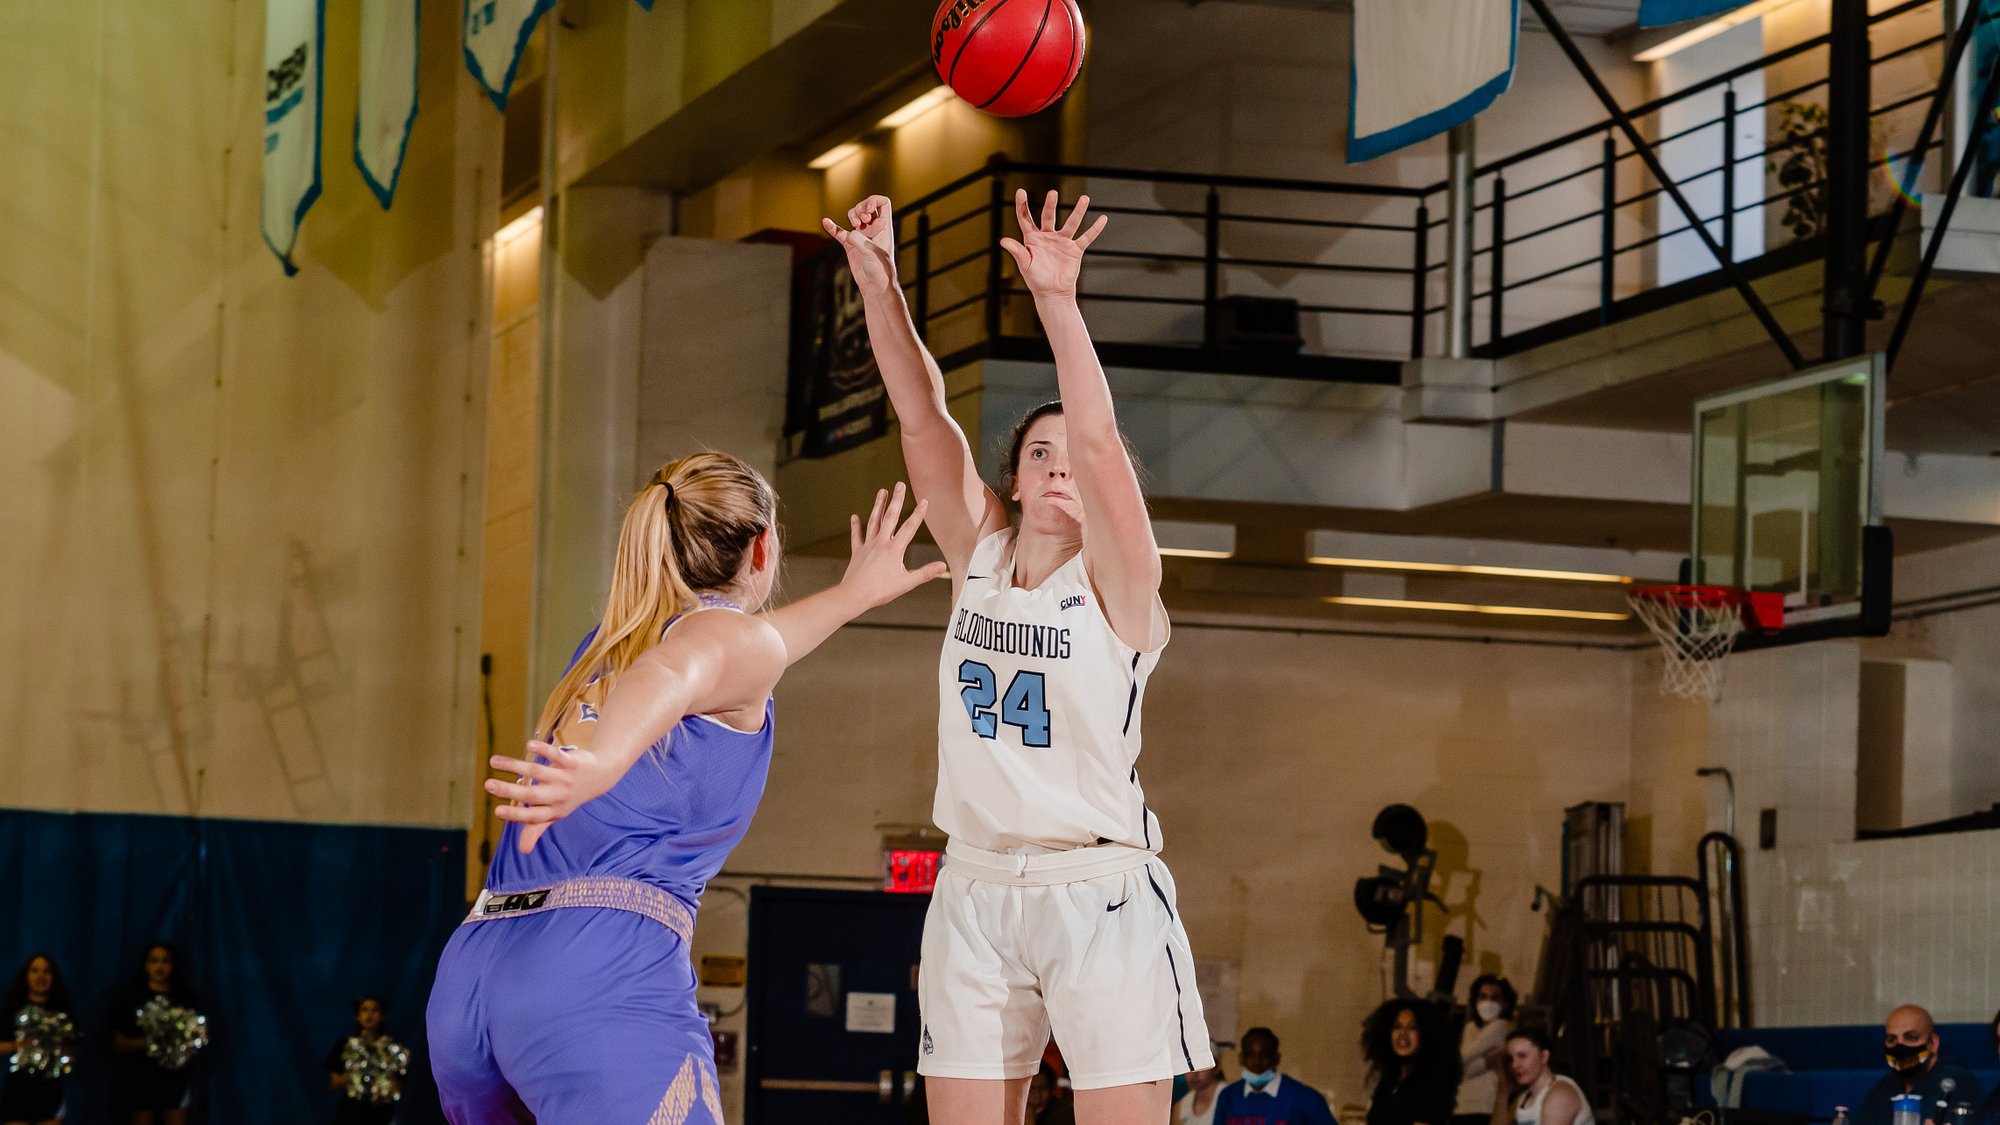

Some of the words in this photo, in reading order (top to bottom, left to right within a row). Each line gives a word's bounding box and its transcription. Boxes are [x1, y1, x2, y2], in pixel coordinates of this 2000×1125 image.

[1060, 595, 1086, 609] CUNY
[954, 608, 1071, 660] BLOODHOUNDS
[958, 658, 1051, 748] 24
